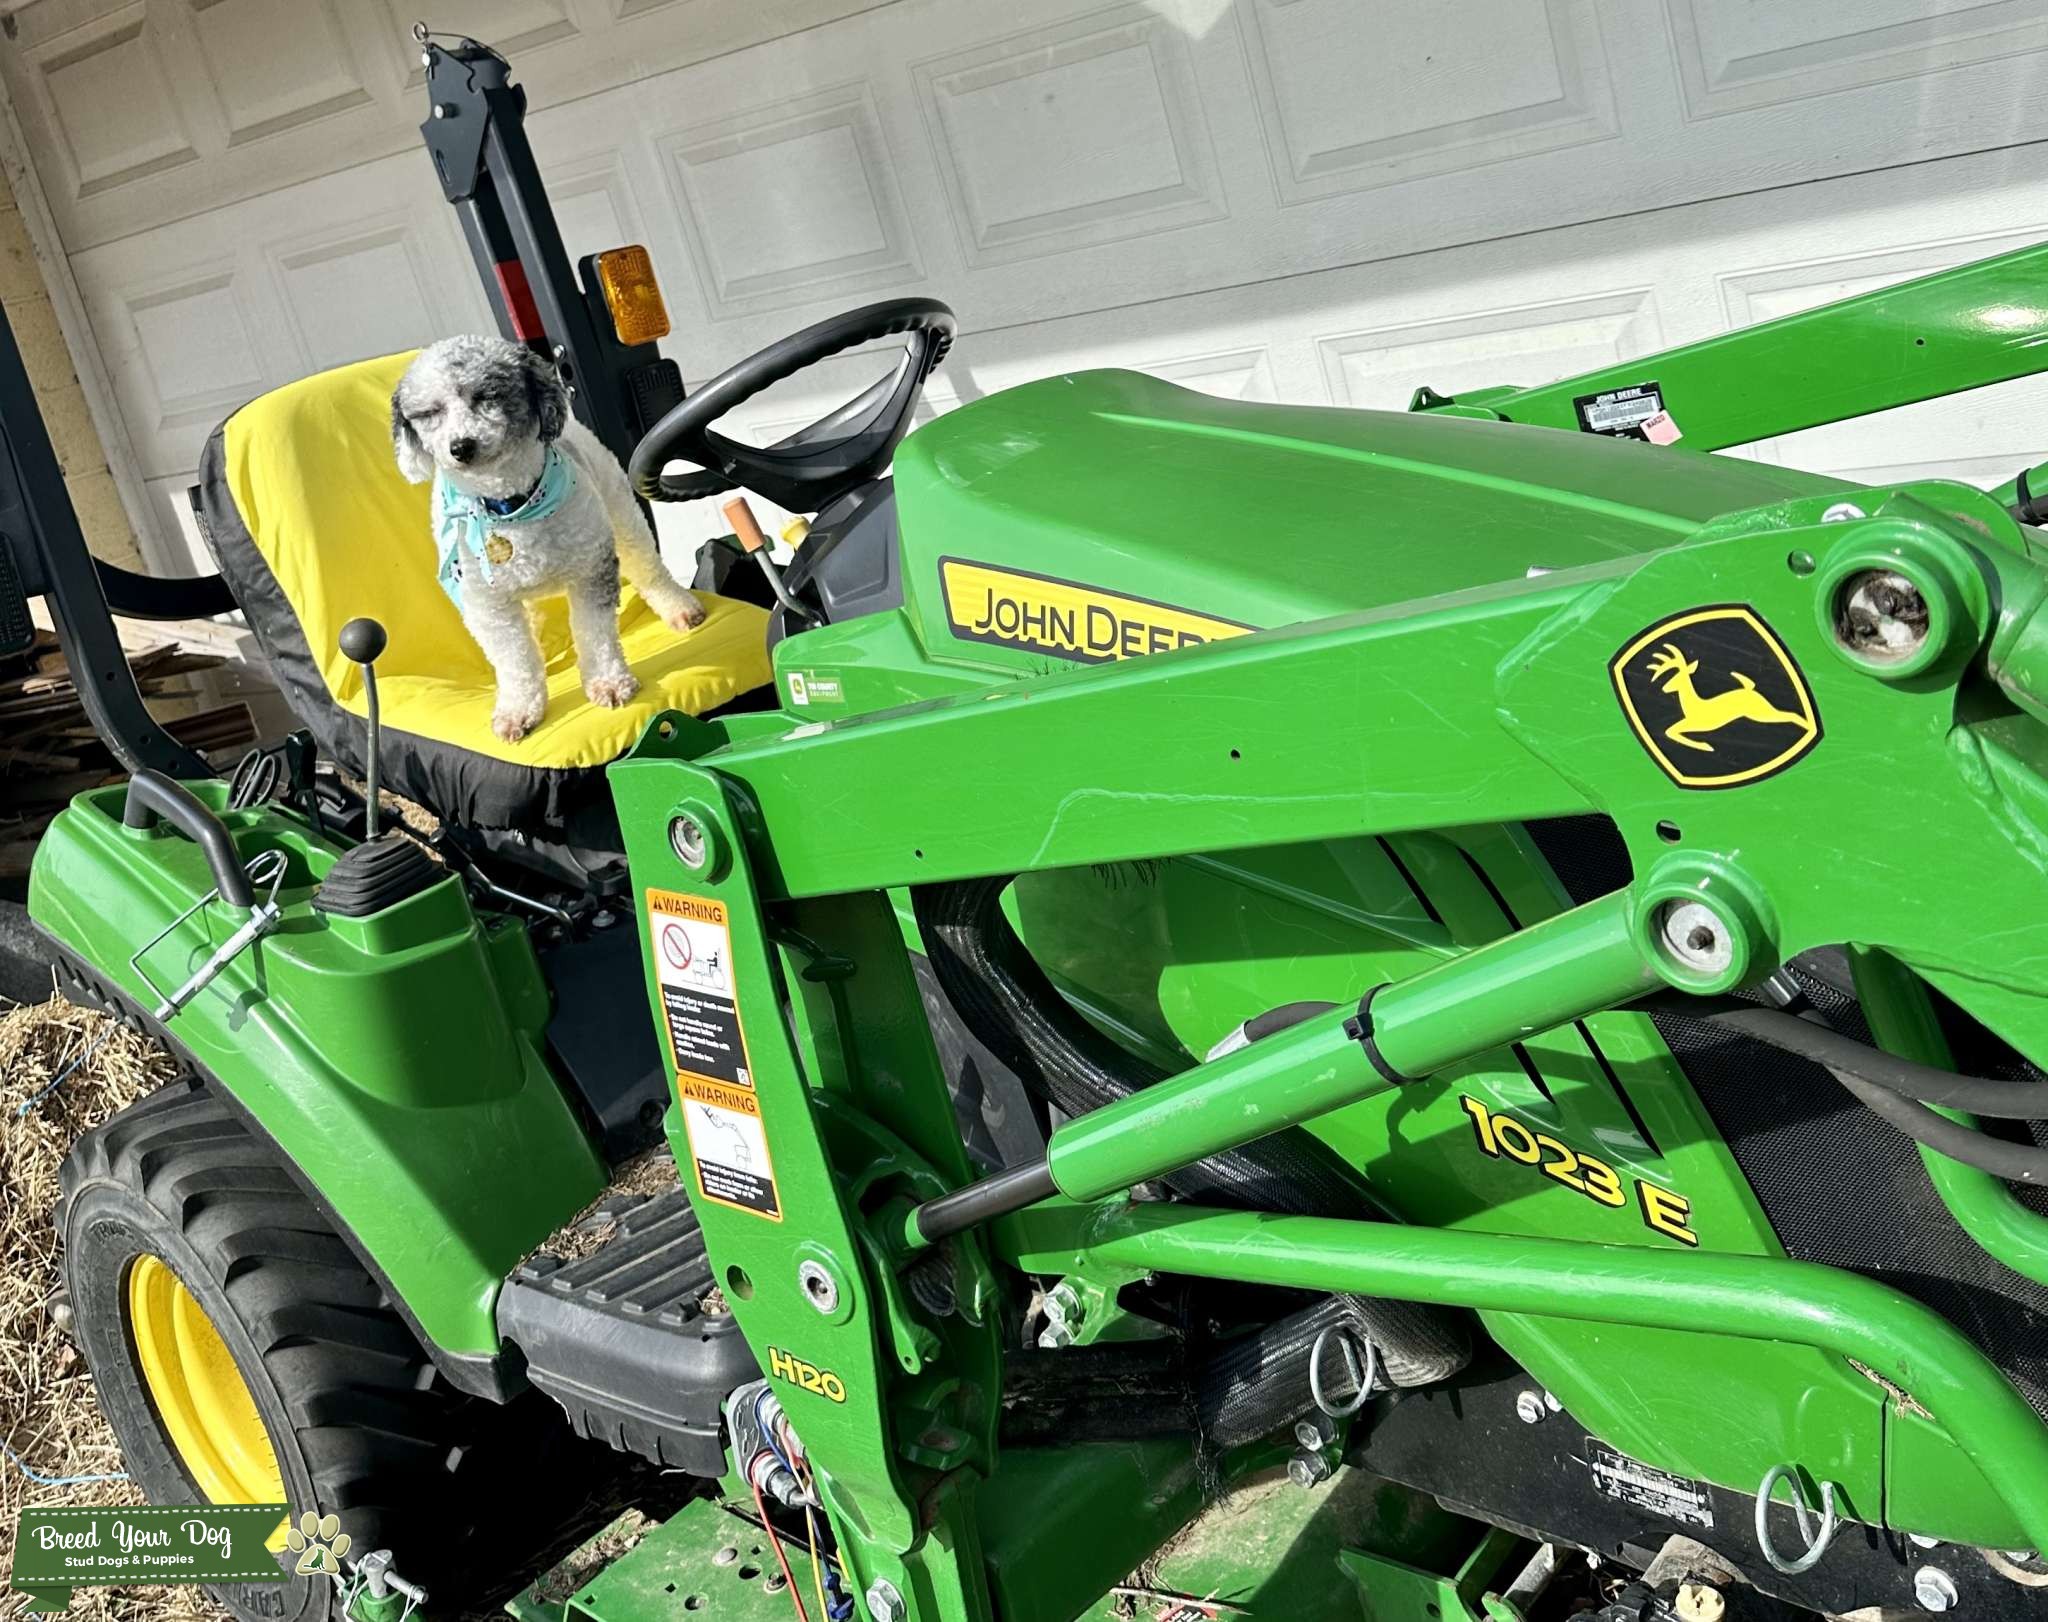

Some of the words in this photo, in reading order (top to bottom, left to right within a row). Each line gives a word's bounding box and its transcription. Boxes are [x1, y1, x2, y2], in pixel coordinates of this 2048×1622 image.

[975, 588, 1074, 645] JOHN
[1087, 605, 1217, 657] DEE
[662, 896, 722, 922] WARNING
[694, 1083, 756, 1112] WARNING
[1459, 1092, 1627, 1208] 1023
[1634, 1179, 1699, 1247] E
[768, 1346, 846, 1403] H120
